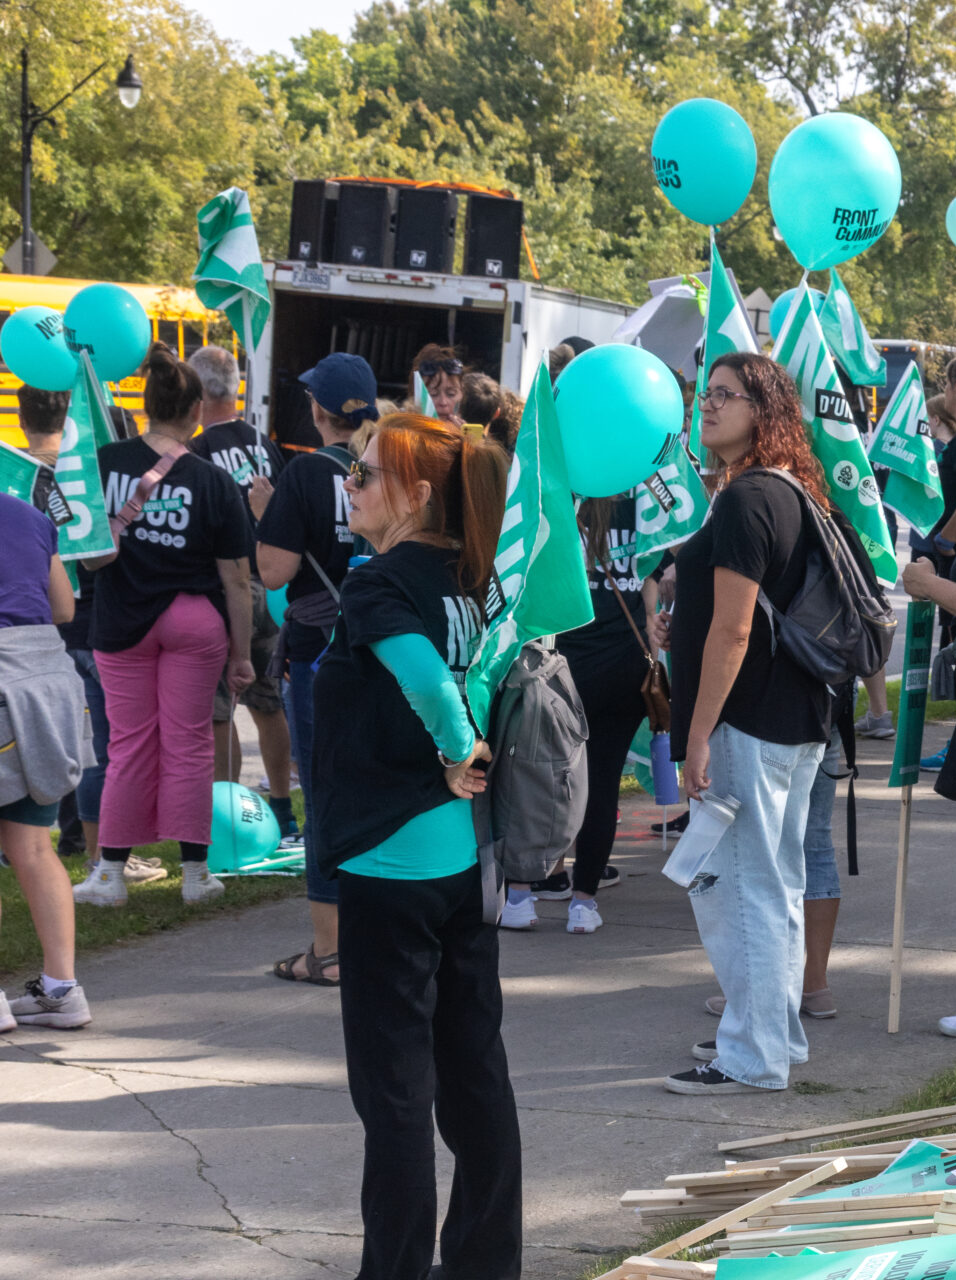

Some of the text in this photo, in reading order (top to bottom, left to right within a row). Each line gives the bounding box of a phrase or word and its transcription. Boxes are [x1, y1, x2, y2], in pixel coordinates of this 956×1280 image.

[832, 207, 879, 227] FRONT
[820, 394, 852, 419] D'UN
[650, 475, 673, 507] VOIX
[837, 475, 851, 488] CSN
[48, 489, 70, 521] VOIX
